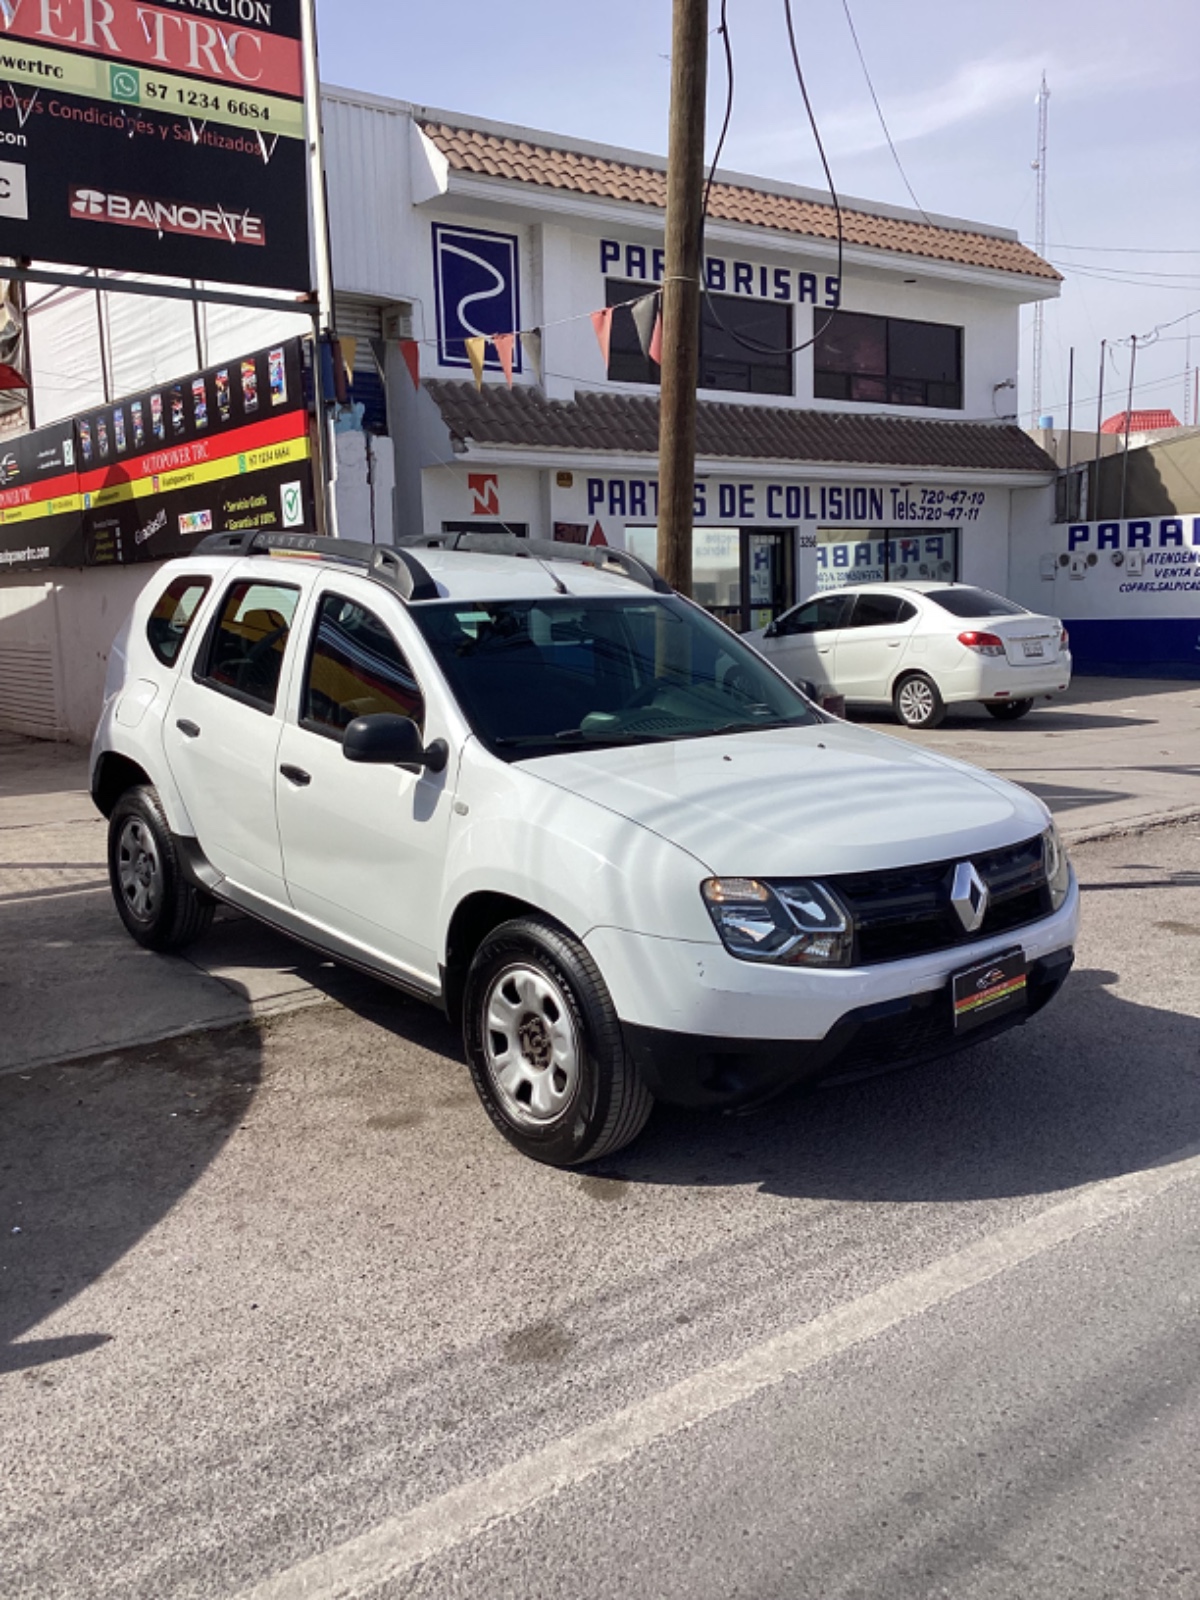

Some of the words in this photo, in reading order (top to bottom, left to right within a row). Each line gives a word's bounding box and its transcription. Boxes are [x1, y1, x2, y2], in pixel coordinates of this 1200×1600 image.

[137, 8, 263, 81] TRC
[0, 55, 64, 79] wertrc
[145, 82, 168, 100] 87
[177, 88, 220, 112] 1234
[227, 99, 270, 121] 6684
[48, 100, 155, 134] Condiciones
[158, 124, 170, 140] y
[106, 194, 263, 240] BANORTE
[719, 483, 755, 519] DE
[767, 485, 884, 521] COLISION
[890, 488, 920, 520] Tels.
[252, 534, 318, 548] DUSTER
[1154, 567, 1191, 578] VENTA
